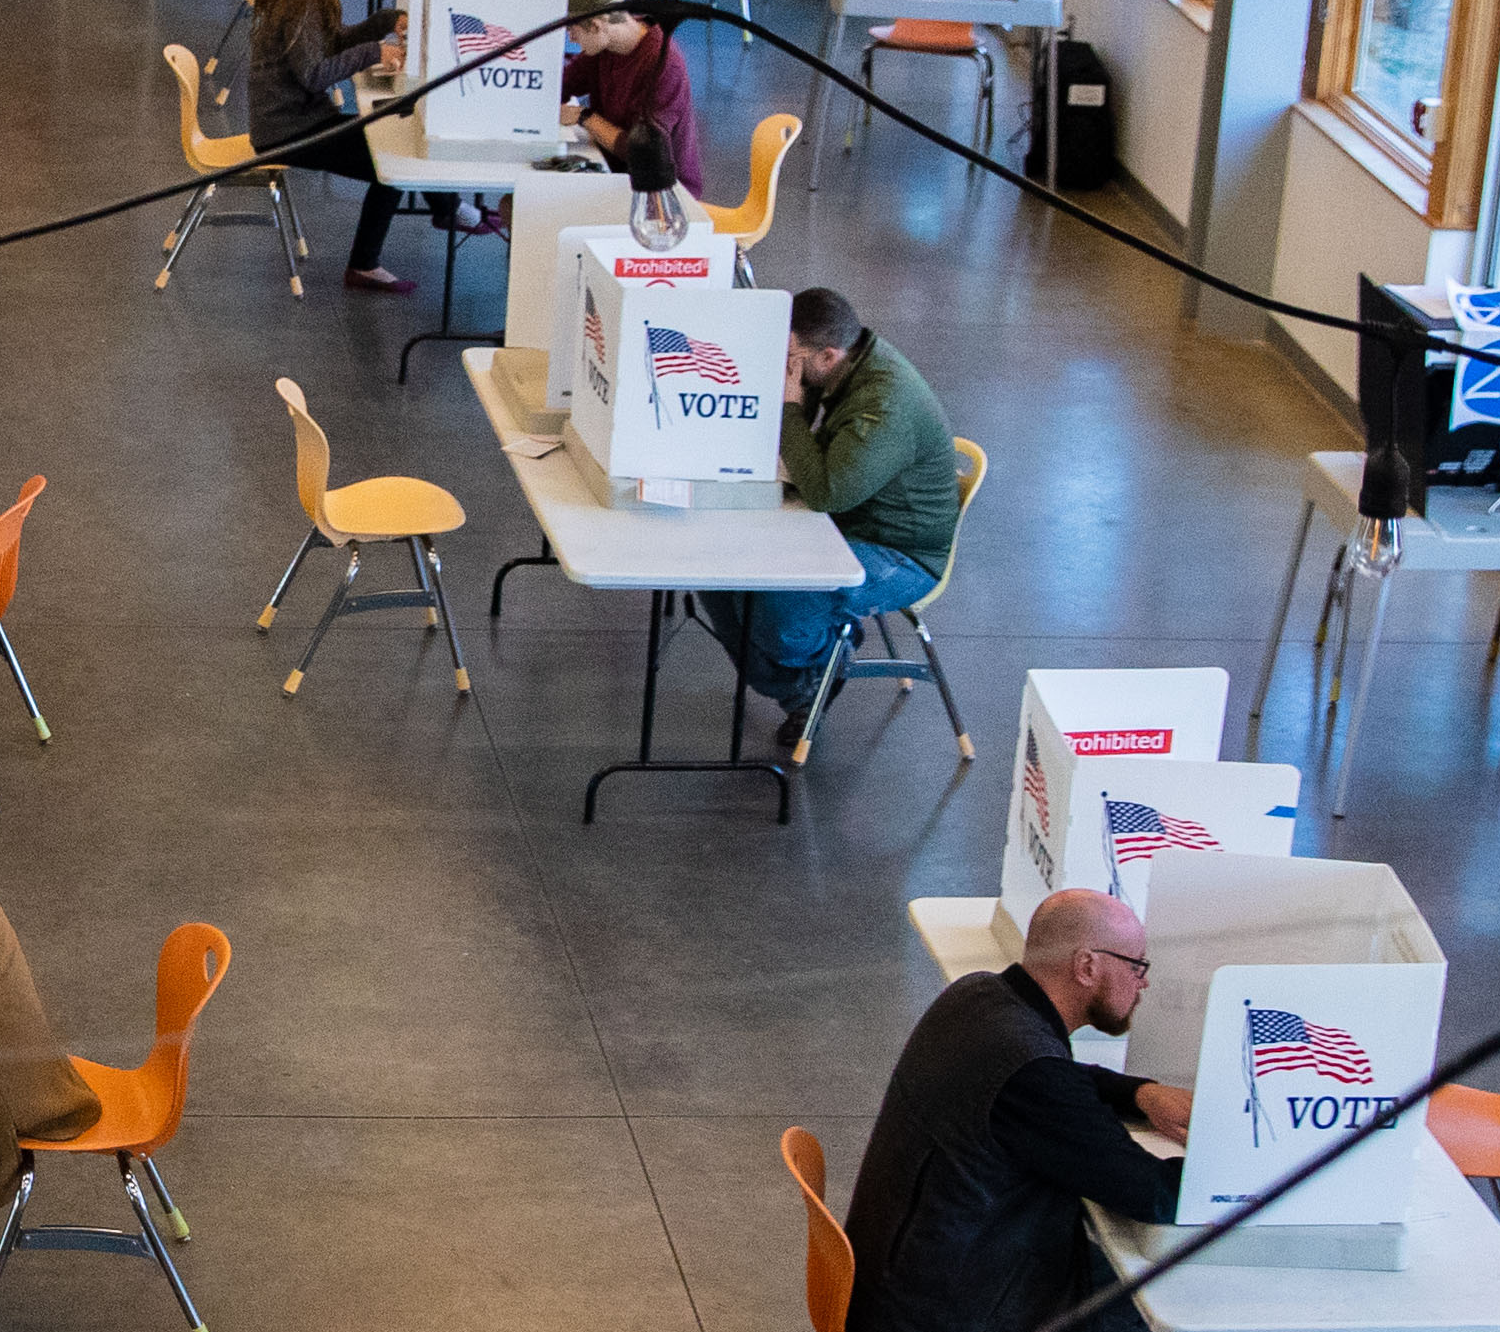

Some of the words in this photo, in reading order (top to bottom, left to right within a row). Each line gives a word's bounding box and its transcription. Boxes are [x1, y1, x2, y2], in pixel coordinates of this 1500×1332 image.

[479, 67, 543, 90] VOTE
[622, 259, 703, 274] Prohibited
[678, 392, 760, 419] VOTE
[1286, 1095, 1400, 1130] VOTE
